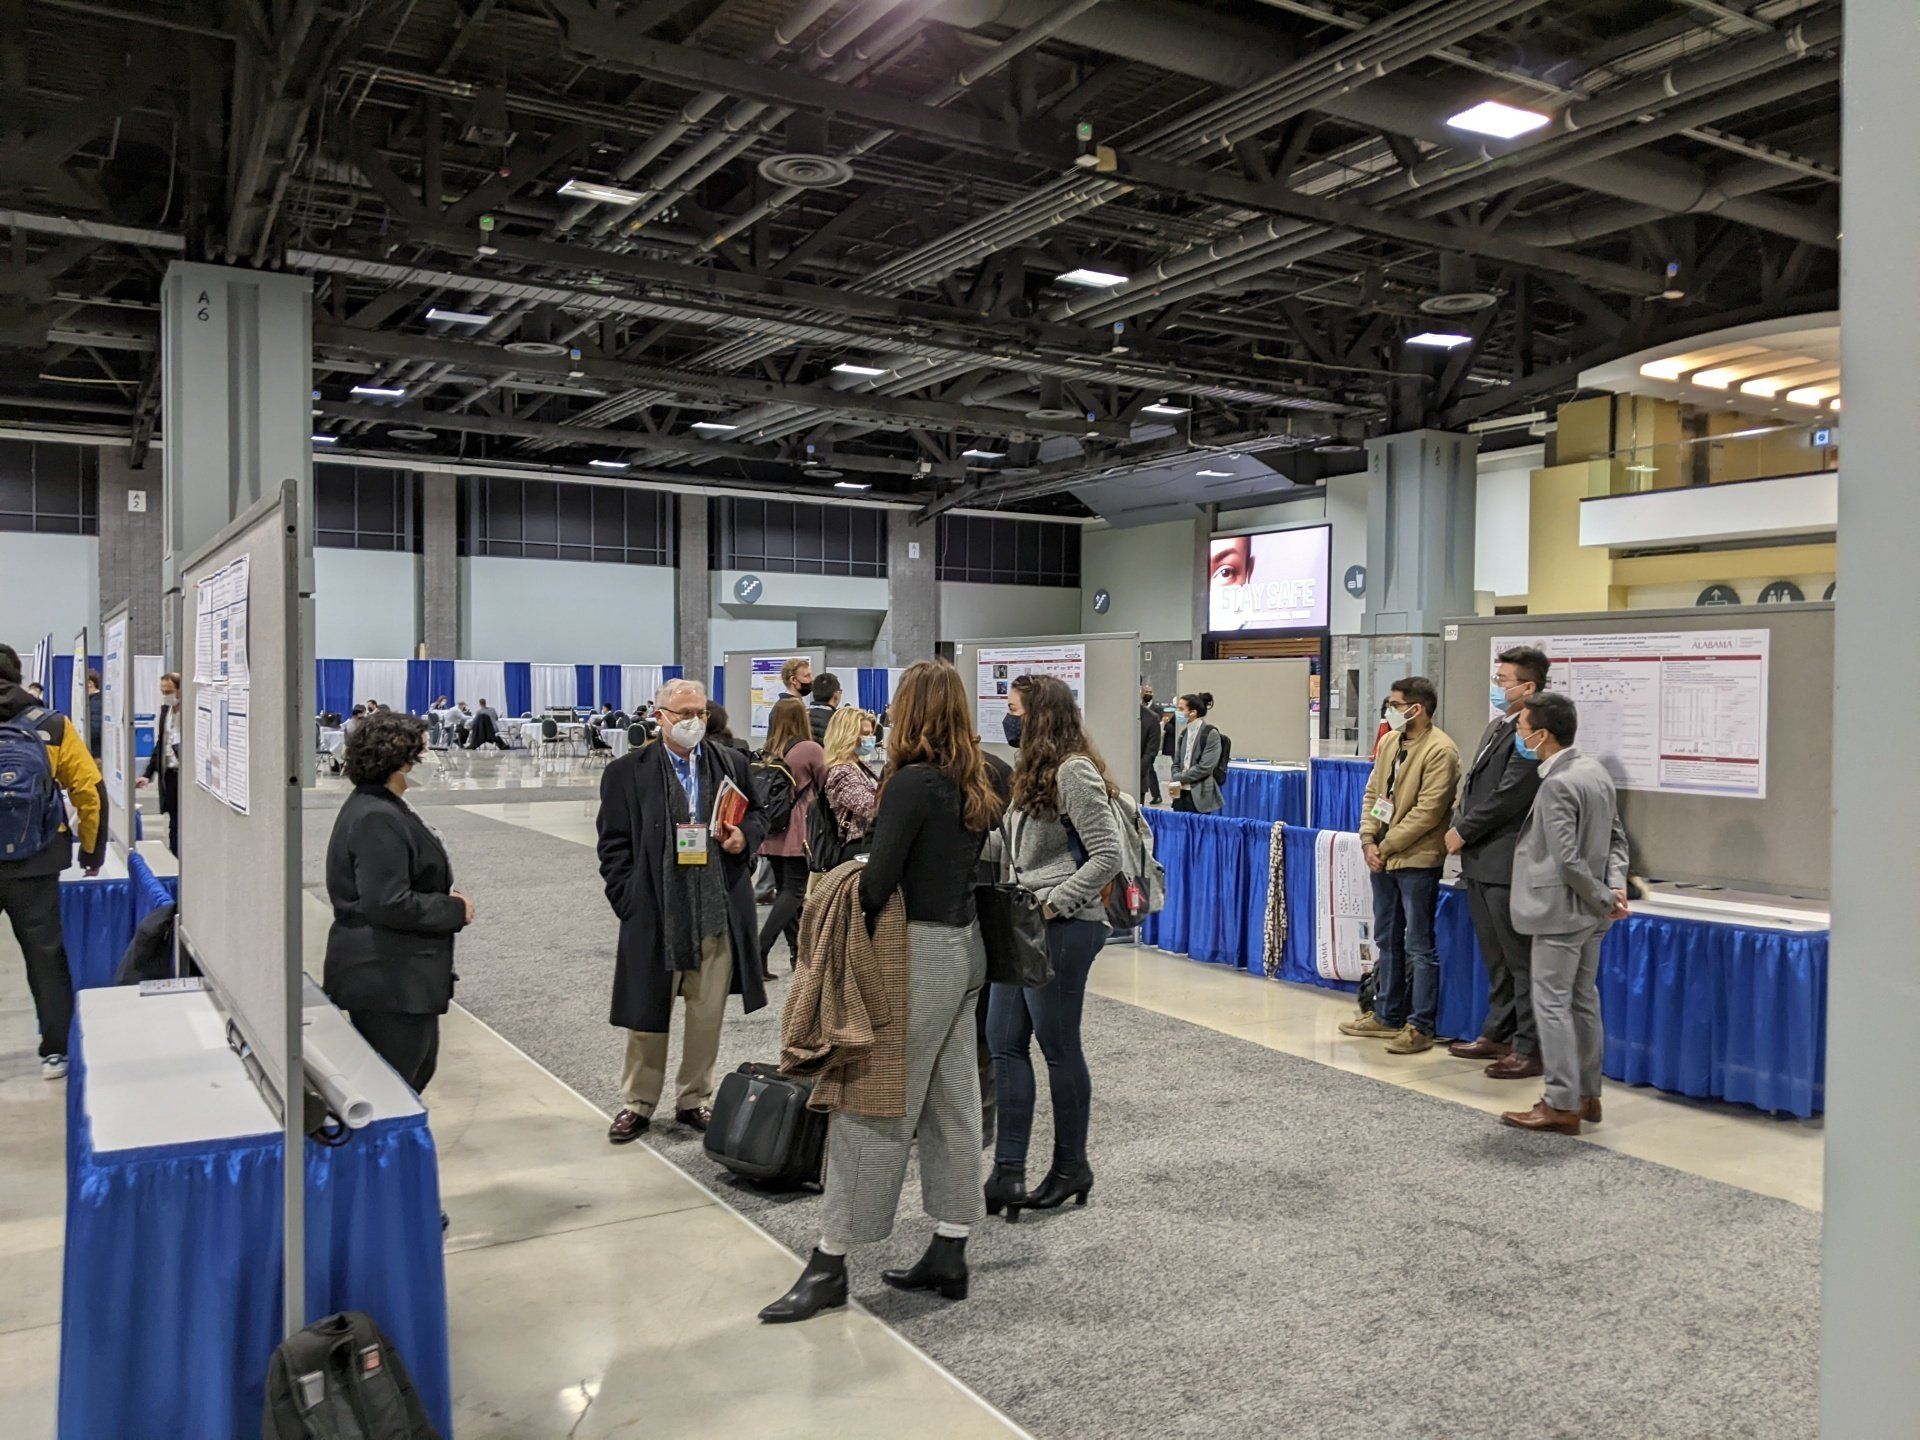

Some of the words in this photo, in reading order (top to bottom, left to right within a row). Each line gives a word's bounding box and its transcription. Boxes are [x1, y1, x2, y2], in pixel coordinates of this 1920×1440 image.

[198, 290, 210, 305] A
[197, 307, 210, 321] 6
[1222, 583, 1264, 611] STAY
[1267, 579, 1315, 609] SAFE
[1691, 640, 1733, 649] ALABAMA
